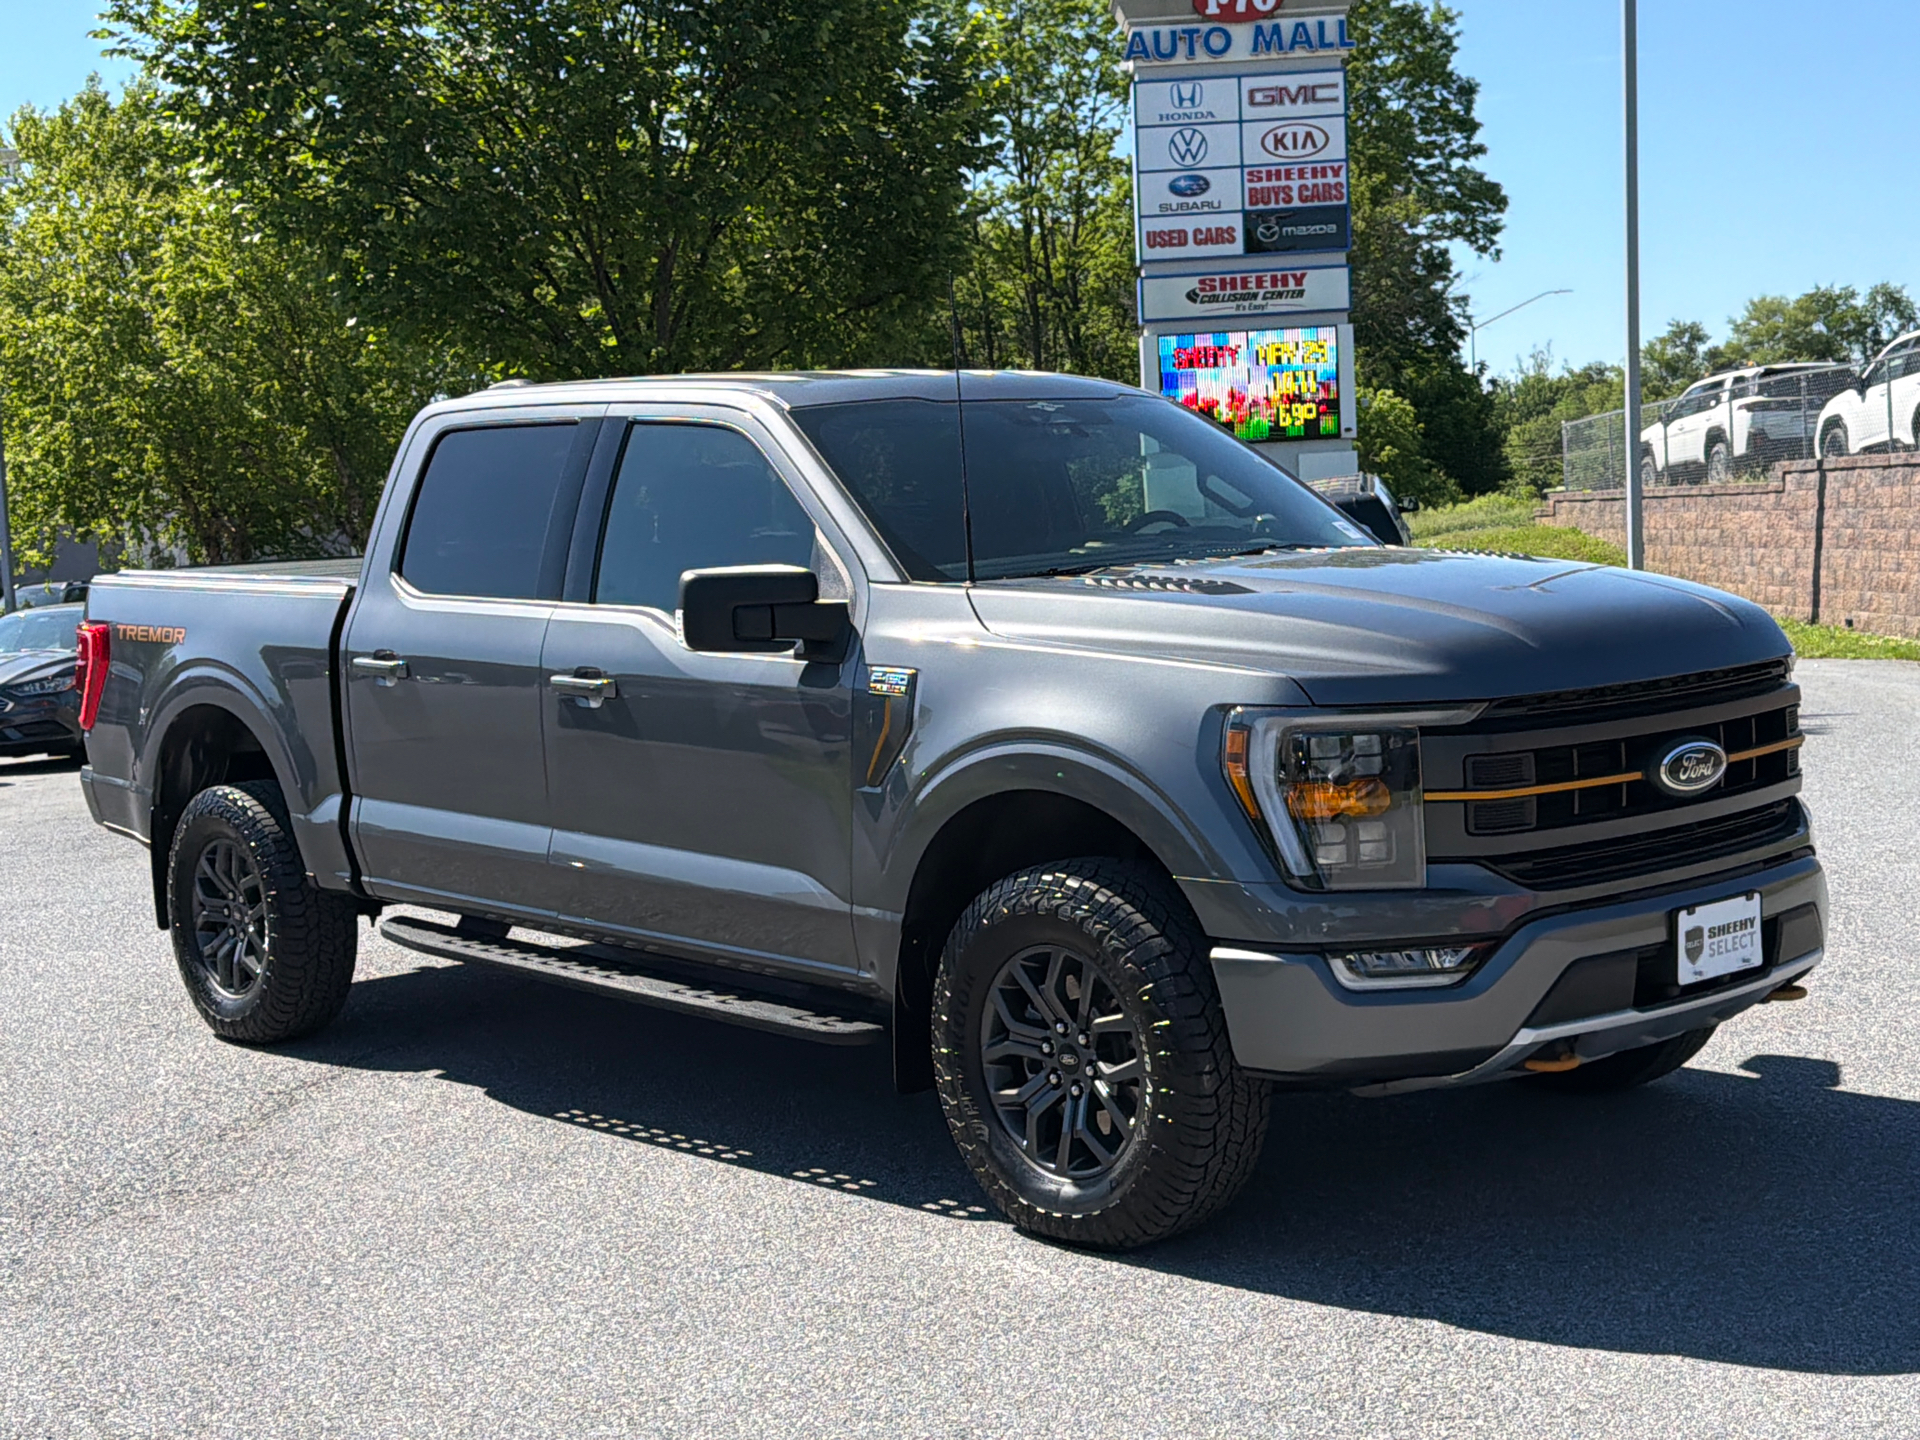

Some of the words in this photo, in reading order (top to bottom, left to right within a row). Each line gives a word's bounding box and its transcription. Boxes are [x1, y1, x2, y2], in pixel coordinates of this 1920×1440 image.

[1123, 26, 1232, 61] AUTO
[1251, 18, 1356, 55] MALL
[1247, 82, 1340, 107] GMC
[1158, 110, 1217, 122] HONDA
[1272, 130, 1319, 152] KIA
[1246, 164, 1344, 184] SHEEHY
[1247, 184, 1294, 207] BUYS
[1297, 181, 1345, 204] CARS
[1158, 199, 1222, 213] SUBARU
[1145, 228, 1188, 249] USED
[1192, 225, 1237, 246] CARS
[1282, 223, 1338, 236] mazda
[1197, 271, 1308, 293] SHEEHY
[1199, 291, 1260, 305] COLLISION
[1261, 288, 1306, 301] CENTER
[116, 624, 187, 645] TREMOR
[1679, 752, 1715, 780] Ford
[1707, 916, 1757, 940] SHEEHY
[1708, 930, 1757, 958] SELECT
